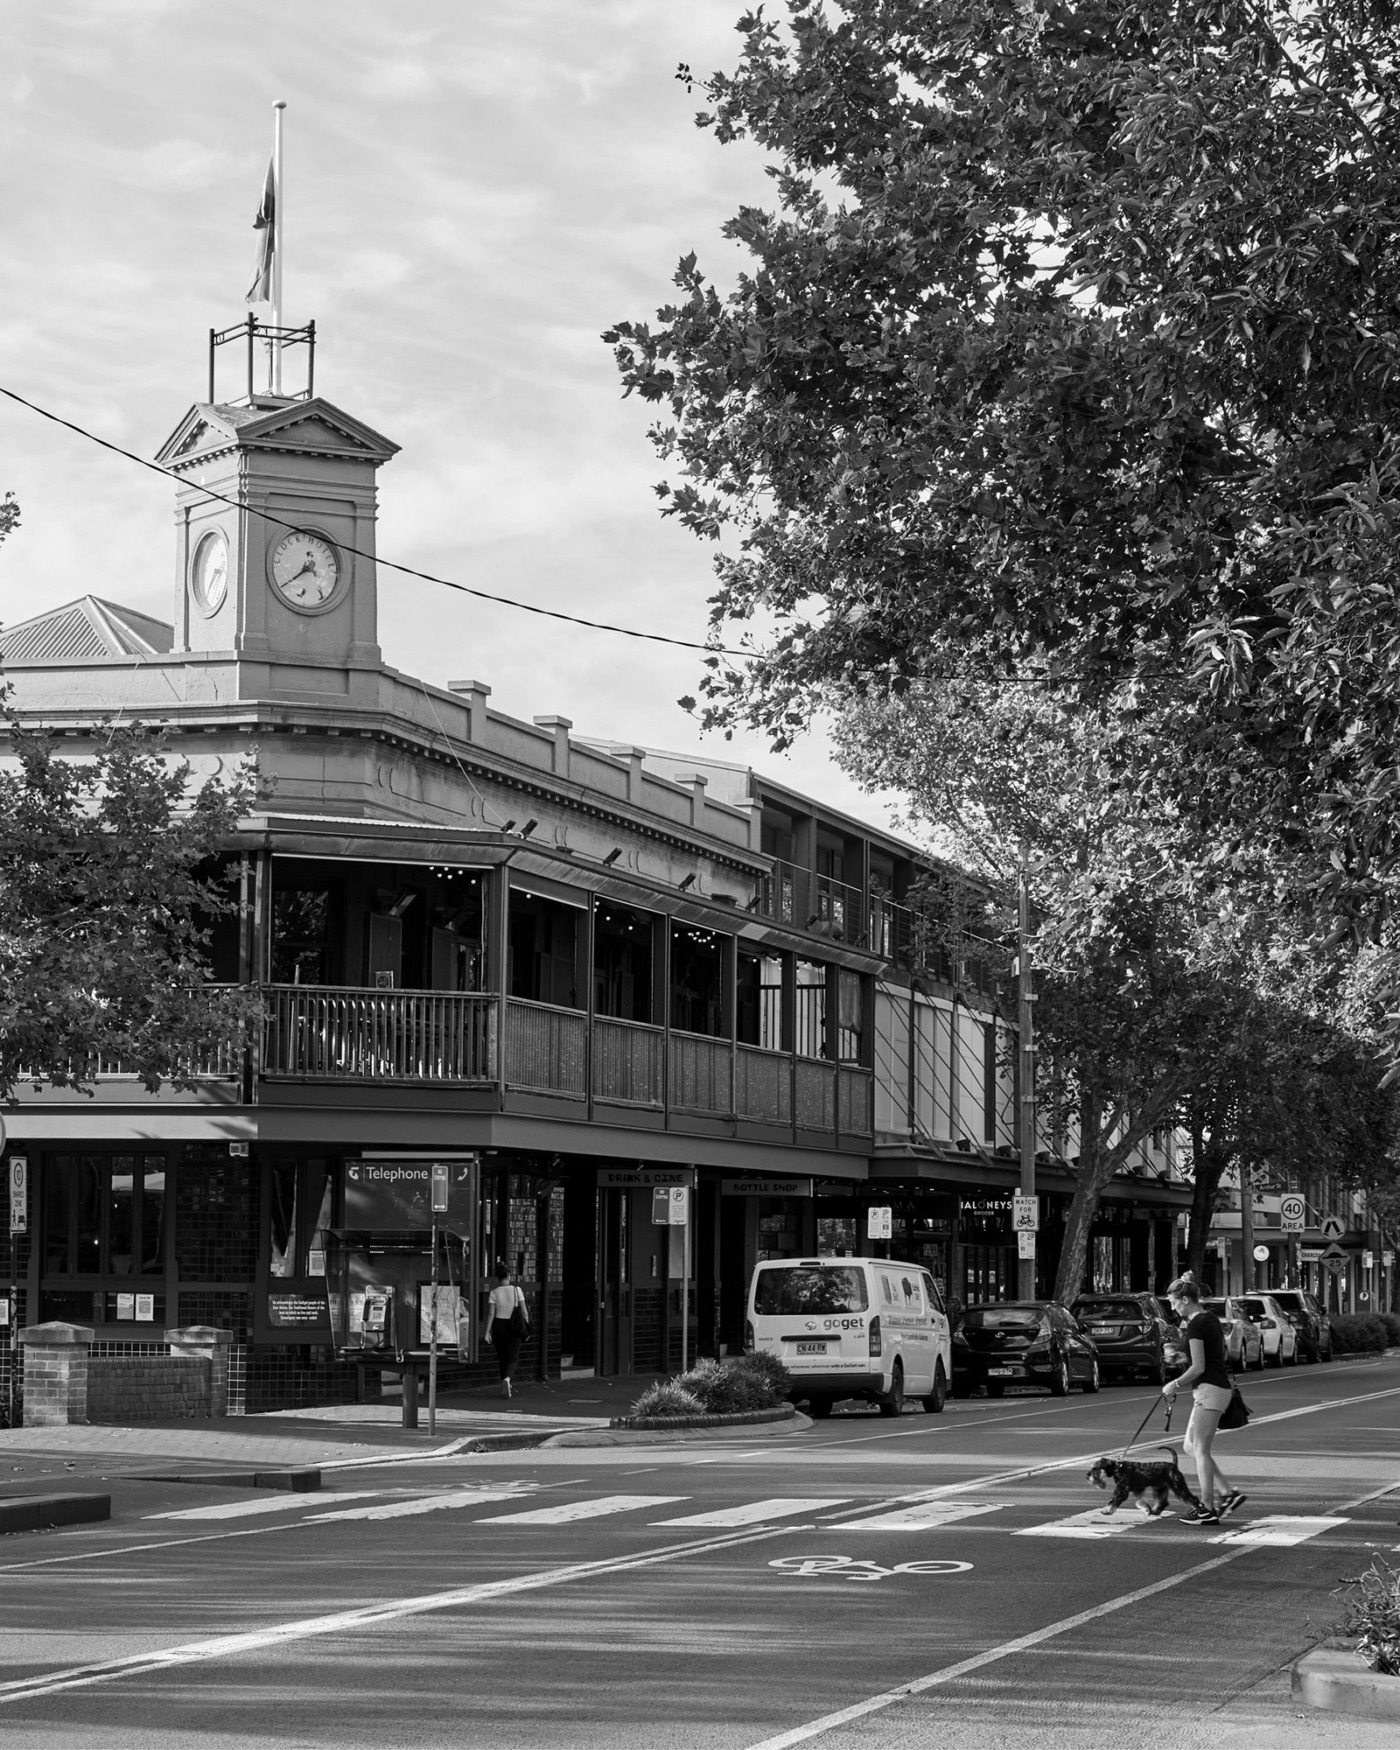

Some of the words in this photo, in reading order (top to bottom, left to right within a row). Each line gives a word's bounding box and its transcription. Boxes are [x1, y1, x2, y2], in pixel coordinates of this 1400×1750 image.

[274, 537, 301, 564] CLOCK
[308, 537, 335, 568] HOTEL
[366, 1167, 428, 1182] Telephone
[607, 1174, 641, 1182] DRINK
[643, 1174, 650, 1183] &
[654, 1174, 684, 1182] DINE
[733, 1183, 769, 1191] BOTTLE
[773, 1184, 798, 1192] SHOP
[1284, 1203, 1301, 1215] 40
[1281, 1222, 1304, 1230] AREA
[823, 1317, 865, 1330] goget
